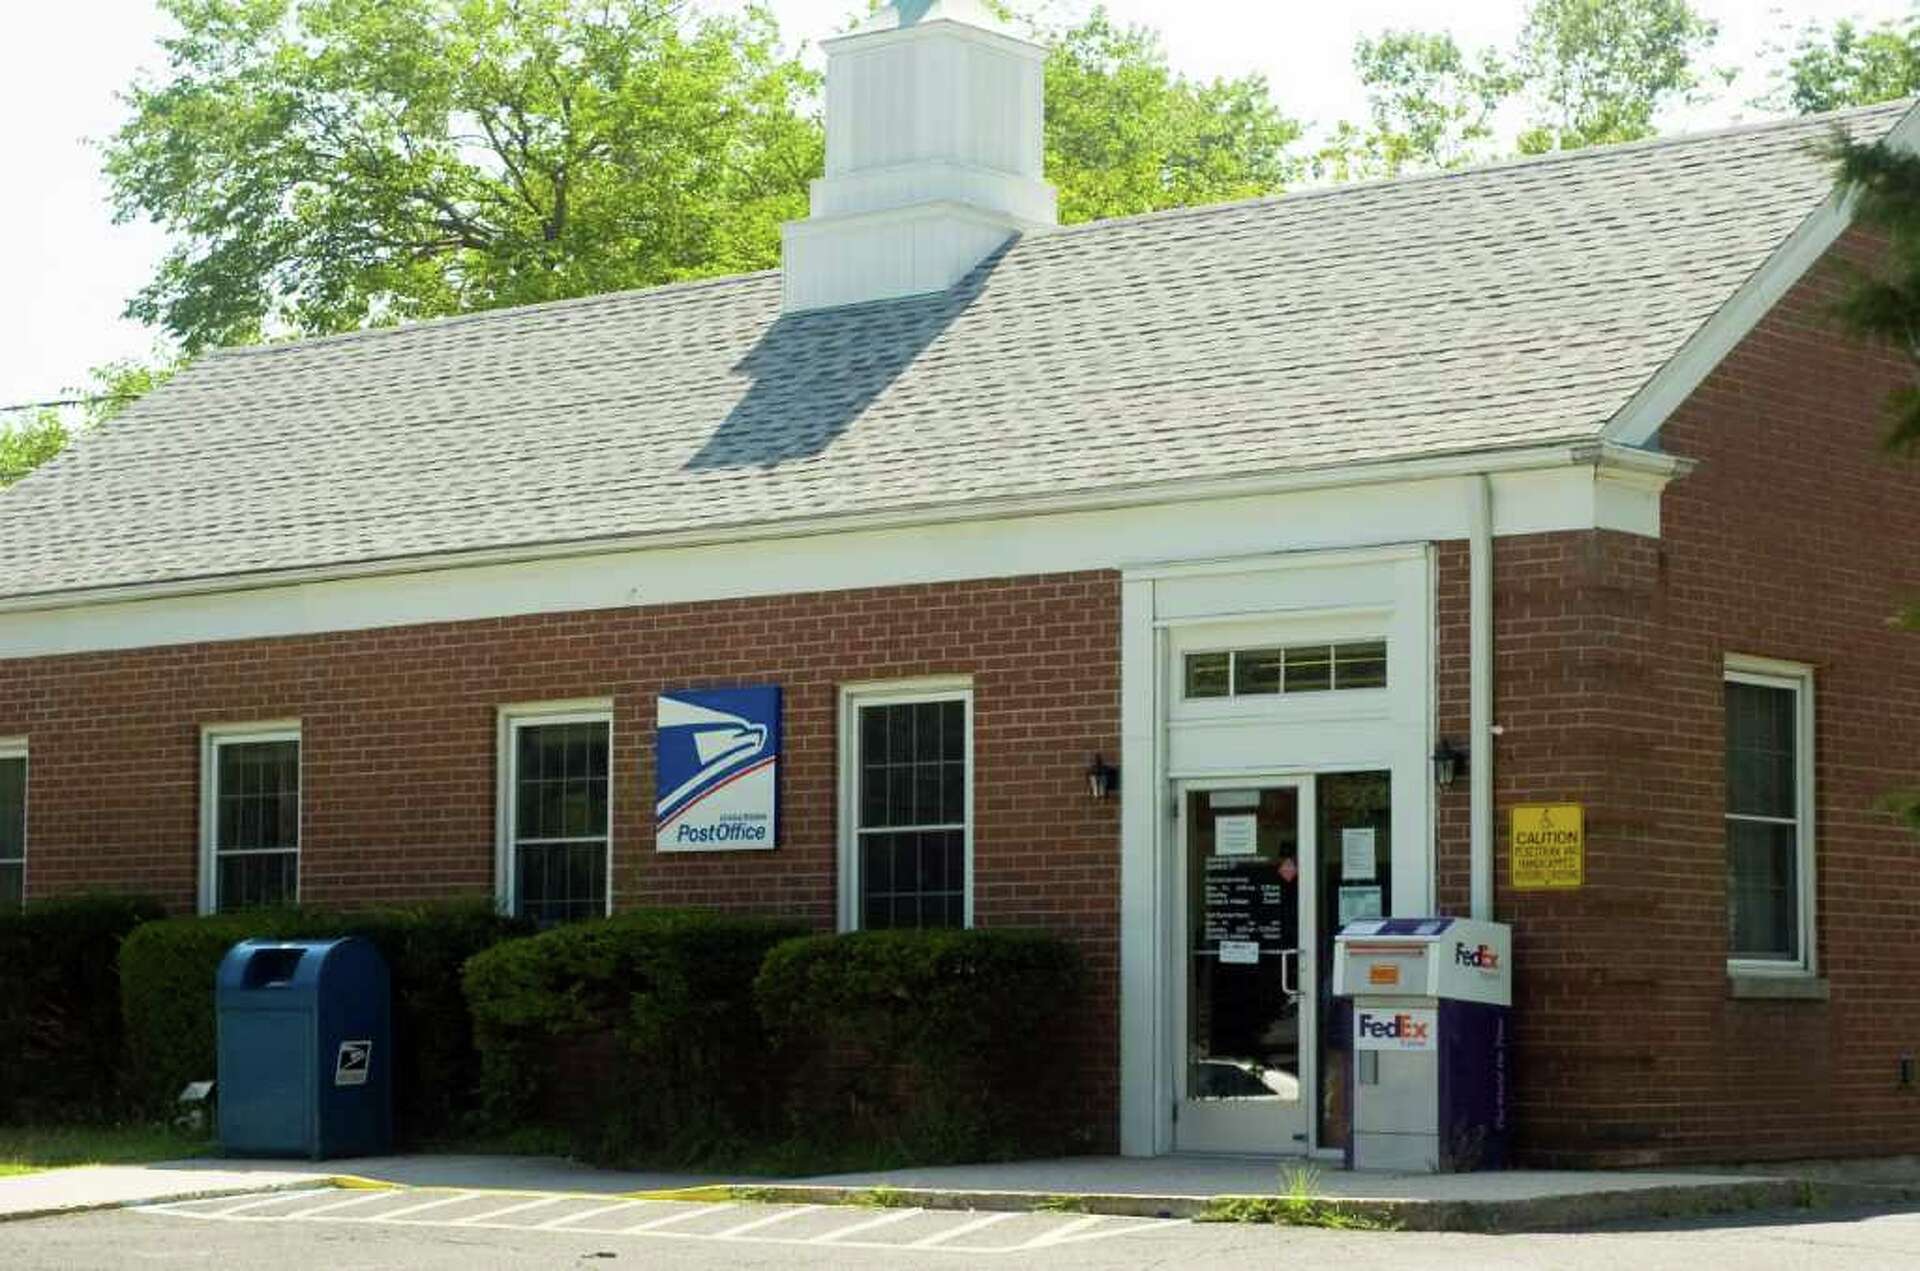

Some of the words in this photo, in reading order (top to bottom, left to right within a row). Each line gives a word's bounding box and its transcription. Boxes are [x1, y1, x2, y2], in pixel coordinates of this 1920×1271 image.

[1516, 831, 1578, 845] CAUTION
[1456, 942, 1499, 969] FedEx
[1360, 1014, 1429, 1038] FedEx
